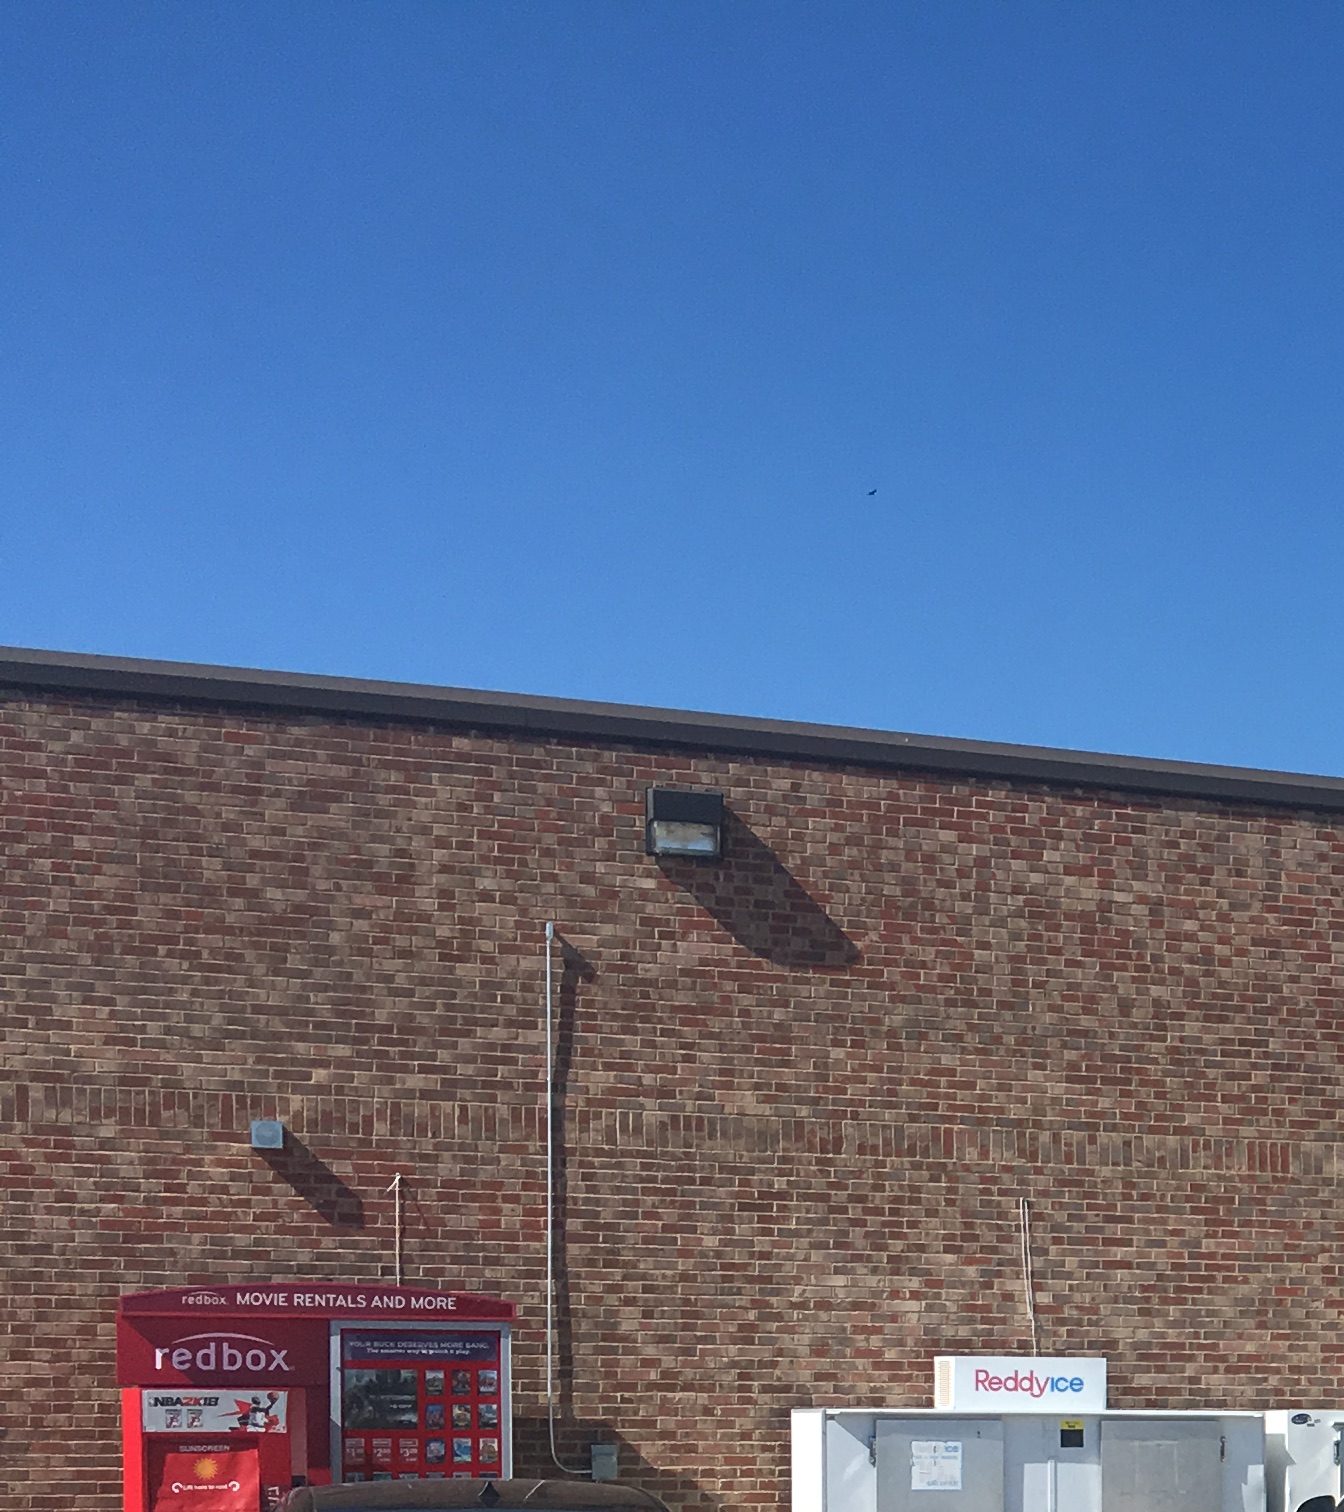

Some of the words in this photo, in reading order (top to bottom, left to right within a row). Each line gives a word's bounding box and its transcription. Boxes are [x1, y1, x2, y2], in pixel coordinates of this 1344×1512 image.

[181, 1293, 226, 1305] redbox
[236, 1292, 289, 1307] MOVIE
[293, 1293, 366, 1308] RENTALS
[370, 1296, 406, 1310] AND
[410, 1296, 457, 1311] MORE
[154, 1342, 290, 1371] redbox
